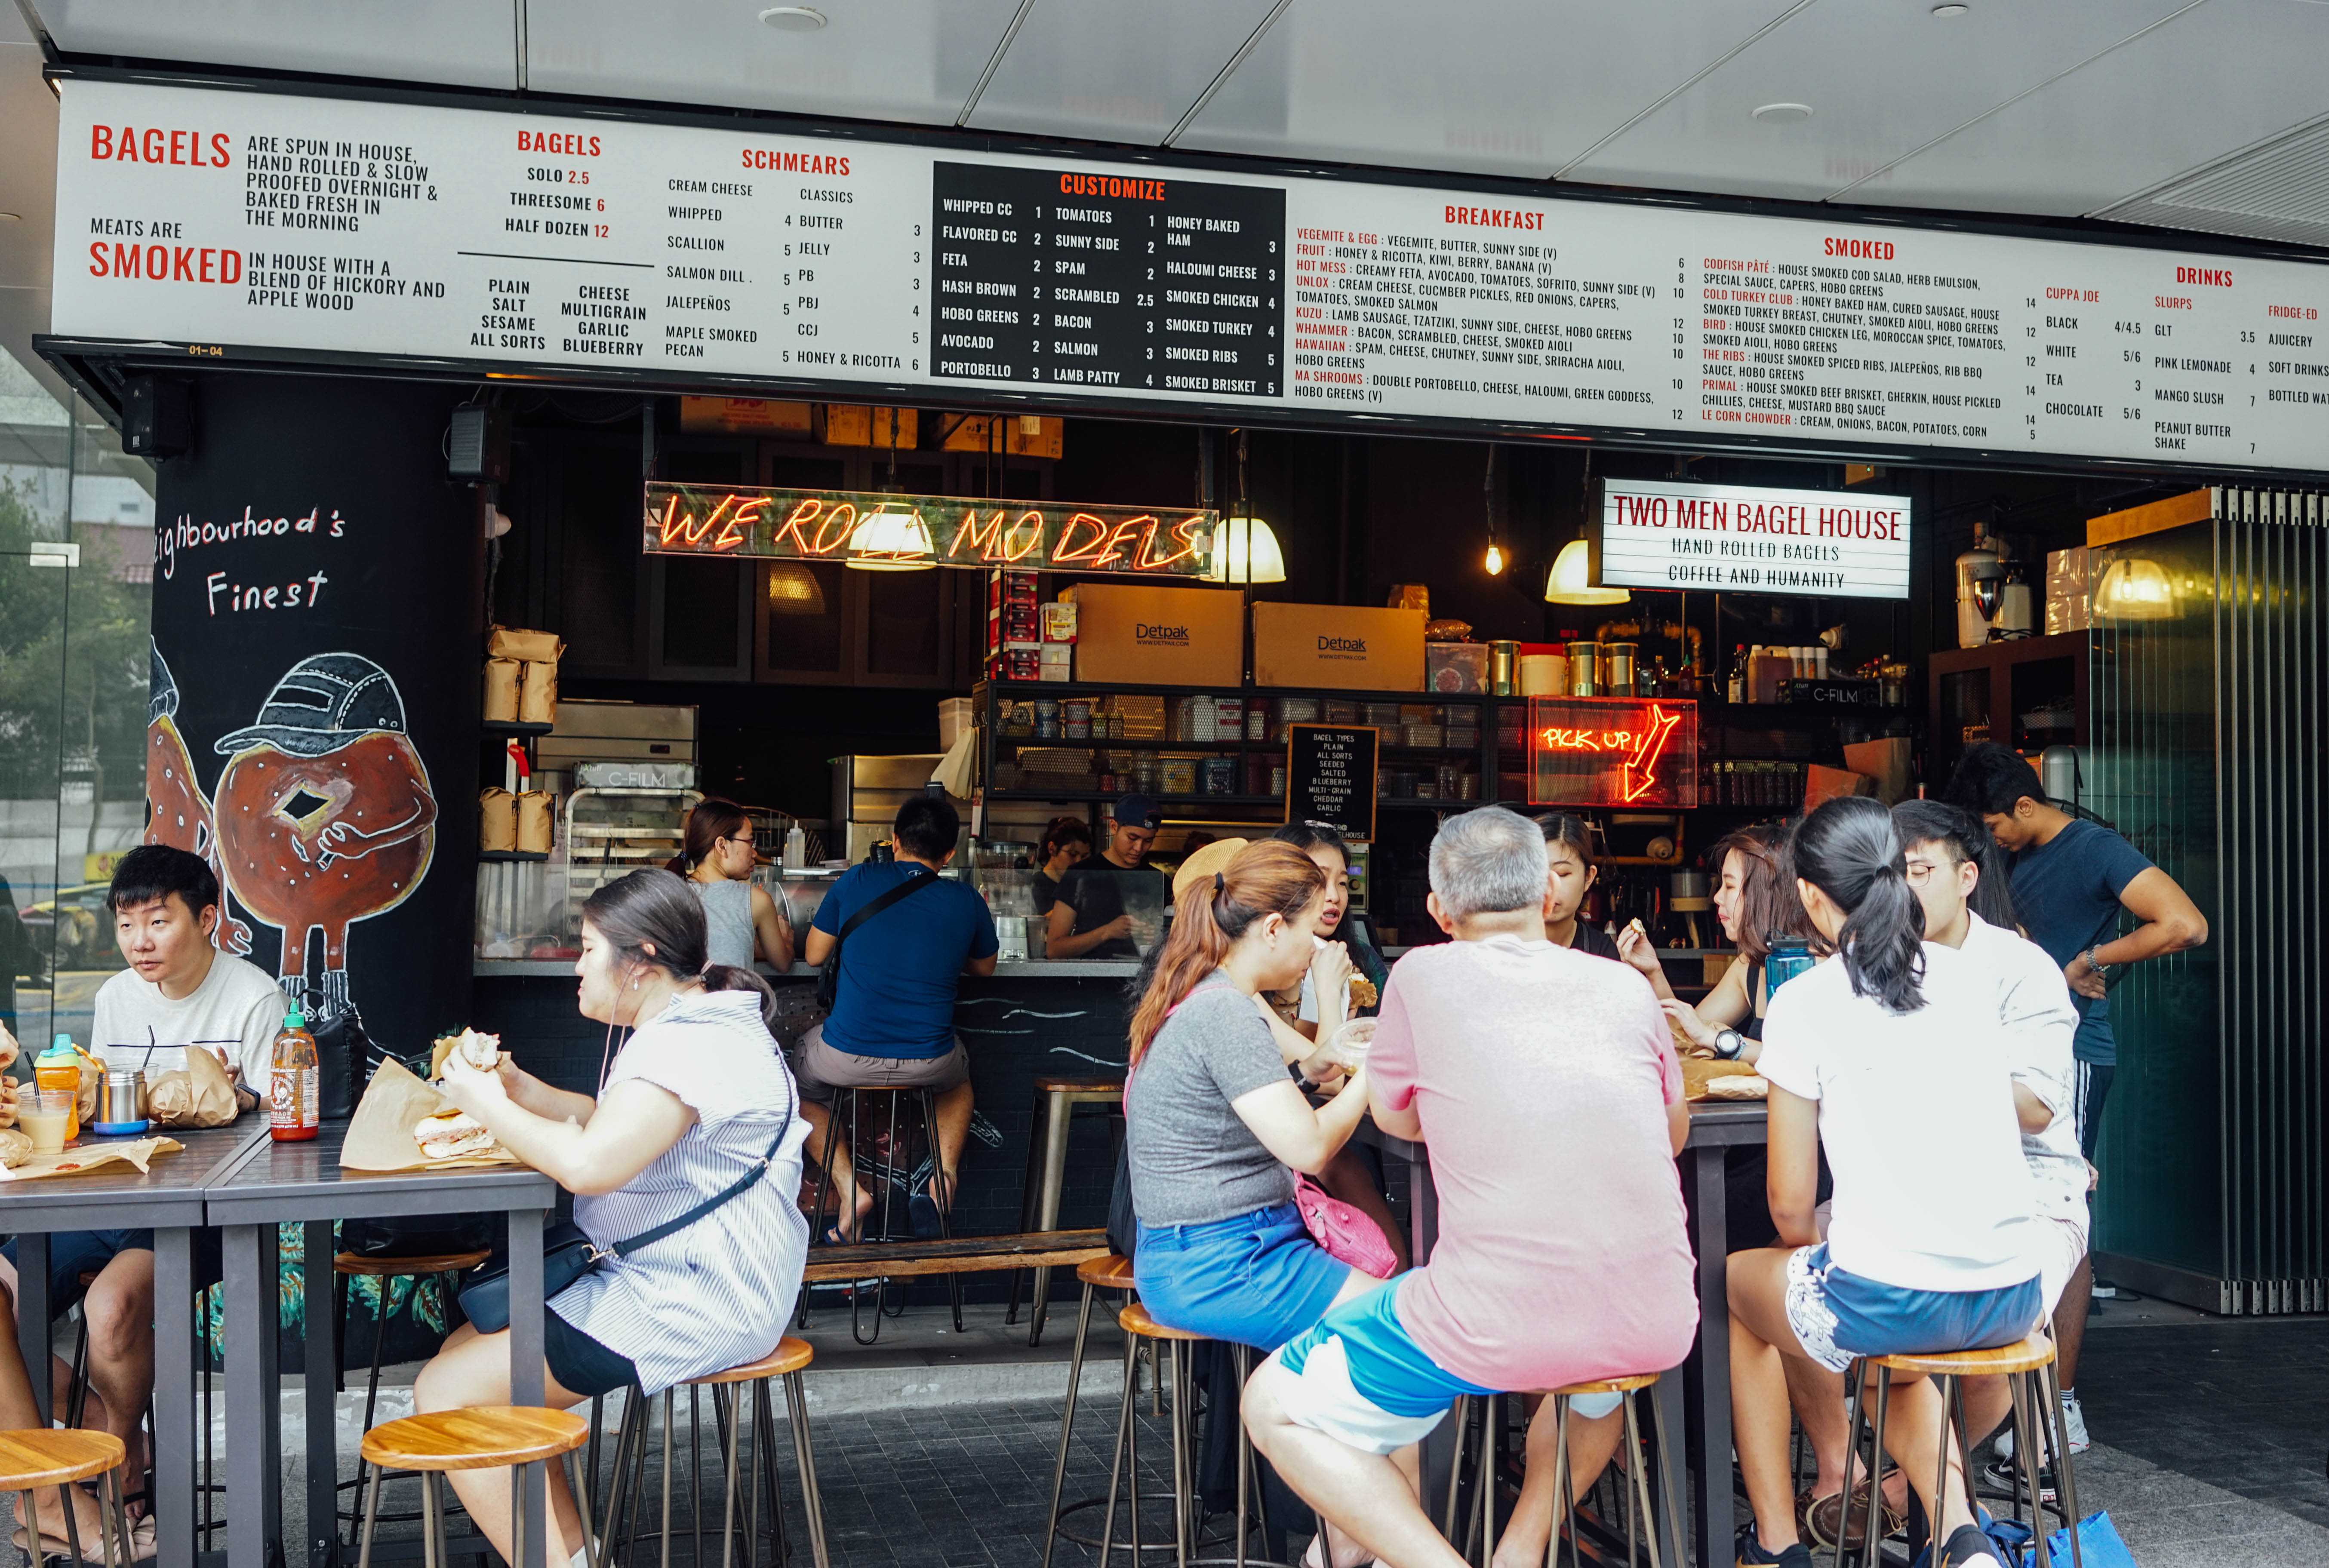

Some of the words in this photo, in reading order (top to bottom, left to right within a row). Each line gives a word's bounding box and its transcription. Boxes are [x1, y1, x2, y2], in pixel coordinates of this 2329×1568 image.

[91, 124, 230, 168] BAGELS
[247, 135, 279, 153] ARE
[286, 138, 328, 157] SPUN
[336, 142, 351, 158] IN
[359, 143, 417, 165] HOUSE,
[517, 130, 600, 157] BAGELS
[247, 154, 292, 172] HAND
[300, 157, 360, 177] ROLLED
[367, 162, 377, 178] &
[385, 163, 428, 182] SLOW
[742, 149, 850, 176] SCHMEARS
[527, 167, 563, 182] SOLO
[568, 170, 589, 184] 2.5
[247, 172, 321, 192] PROOFED
[329, 178, 421, 200] OVERNIGHT
[428, 185, 437, 201] &
[669, 179, 707, 193] CREAM
[712, 182, 753, 197] CHEESE
[800, 188, 853, 203] CLASSICS
[1060, 174, 1165, 201] CUSTOMIZE
[246, 191, 299, 209] BAKED
[307, 195, 357, 213] FRESH
[365, 199, 380, 215] IN
[510, 192, 591, 211] THREESOME
[597, 199, 605, 212] 6
[943, 198, 994, 214] WHIPPED
[997, 203, 1012, 216] CC
[1036, 206, 1040, 218] 1
[245, 209, 275, 227] THE
[282, 212, 358, 232] MORNING
[668, 206, 722, 221] WHIPPED
[785, 215, 791, 227] 4
[1055, 207, 1112, 224] TOMATOES
[1149, 215, 1154, 227] 1
[1167, 216, 1202, 230] HONEY
[1206, 219, 1240, 233] BAKED
[1445, 206, 1544, 231] BREAKFAST
[91, 218, 143, 237] MEATS
[150, 221, 182, 239] ARE
[505, 218, 539, 233] HALF
[545, 221, 588, 237] DOZEN
[594, 224, 609, 238] 12
[1167, 233, 1191, 246] HAM
[1269, 241, 1276, 253] 3
[1297, 228, 1344, 242] VEGEMITE
[1348, 232, 1354, 243] &
[1359, 233, 1377, 245] EGG
[1388, 235, 1437, 251] VEGEMITE,
[1440, 239, 1480, 254] BUTTER,
[1483, 243, 1515, 255] SUNNY
[1519, 246, 1540, 258] SIDE
[1543, 247, 1557, 261] (V)
[1679, 258, 1684, 268] 6
[1824, 237, 1894, 261] SMOKED
[89, 241, 241, 284] SMOKED
[249, 252, 265, 268] IN
[273, 253, 326, 272] HOUSE
[334, 257, 374, 275] WITH
[381, 261, 391, 277] A
[249, 271, 300, 289] BLEND
[308, 274, 327, 291] OF
[334, 276, 406, 295] HICKORY
[412, 281, 445, 298] AND
[2177, 266, 2233, 287] DRINKS
[489, 279, 529, 295] PLAIN
[579, 285, 630, 301] CHEESE
[2046, 287, 2079, 301] CUPPA
[2083, 290, 2099, 302] JOE
[247, 289, 298, 307] APPLE
[305, 292, 353, 311] WOOD
[492, 297, 526, 312] SALT
[666, 295, 730, 311] JALEPEÑOS
[783, 303, 790, 315] 5
[1055, 288, 1120, 304] SCRAMBLED
[1137, 294, 1154, 307] 2.5
[1296, 291, 1351, 307] TOMATOES,
[1354, 295, 1394, 308] SMOKED
[1398, 298, 1437, 311] SALMON
[2155, 296, 2192, 310] SLURPS
[561, 302, 646, 320] MULTIGRAIN
[2269, 305, 2317, 320] FRIDGE-ED
[482, 315, 535, 331] SESAME
[578, 321, 629, 337] GARLIC
[2046, 316, 2078, 329] BLACK
[2114, 321, 2141, 334] 4/4.5
[471, 332, 495, 347] ALL
[501, 334, 545, 350] SORTS
[563, 338, 643, 356] BLUEBERRY
[1703, 333, 1741, 346] SMOKED
[1744, 336, 1770, 350] AIOLI,
[1774, 338, 1800, 350] HOBO
[1803, 341, 1837, 353] GREENS
[2268, 333, 2312, 347] AJUICERY
[798, 350, 835, 364] HONEY
[840, 353, 847, 365] &
[852, 354, 901, 369] RICOTTA
[912, 359, 919, 371] 6
[941, 361, 1011, 377] PORTOBELLO
[1032, 367, 1039, 379] 3
[2155, 357, 2178, 369] PINK
[2181, 358, 2231, 373] LEMONADE
[2249, 363, 2255, 375] 4
[2269, 361, 2291, 374] SOFT
[2295, 363, 2329, 377] DRINKS
[1702, 409, 1712, 420] LE
[1716, 410, 1741, 422] CORN
[1745, 412, 1791, 425] CHOWDER
[1800, 415, 1834, 429] CREAM,
[1837, 418, 1874, 431] ONIONS,
[1877, 420, 1910, 434] BACON,
[1913, 422, 1960, 437] POTATOES,
[1963, 425, 1987, 437] CORN
[2030, 429, 2035, 440] 5
[662, 494, 772, 545] WE
[775, 499, 925, 561] ROLL
[1613, 495, 1668, 527] TWO
[1677, 499, 1727, 531] MEN
[1737, 503, 1811, 536] BAGEL
[1819, 508, 1901, 541] HOUSE
[1672, 538, 1713, 555] HAND
[1721, 540, 1776, 558] ROLLED
[1784, 544, 1840, 561] BAGELS
[1669, 565, 1723, 583] COFFEE
[1730, 568, 1760, 584] AND
[1768, 570, 1845, 588] HUMANITY
[207, 570, 328, 617] Finest
[1136, 624, 1189, 639] Detpak
[1318, 636, 1366, 651] Detpak
[1814, 688, 1858, 703] C-FILM
[1543, 729, 1600, 751] PICK
[609, 772, 665, 787] C-FILM
[1312, 777, 1351, 786] BLUEBERRY
[1308, 786, 1351, 795] MULTI-GRAIN
